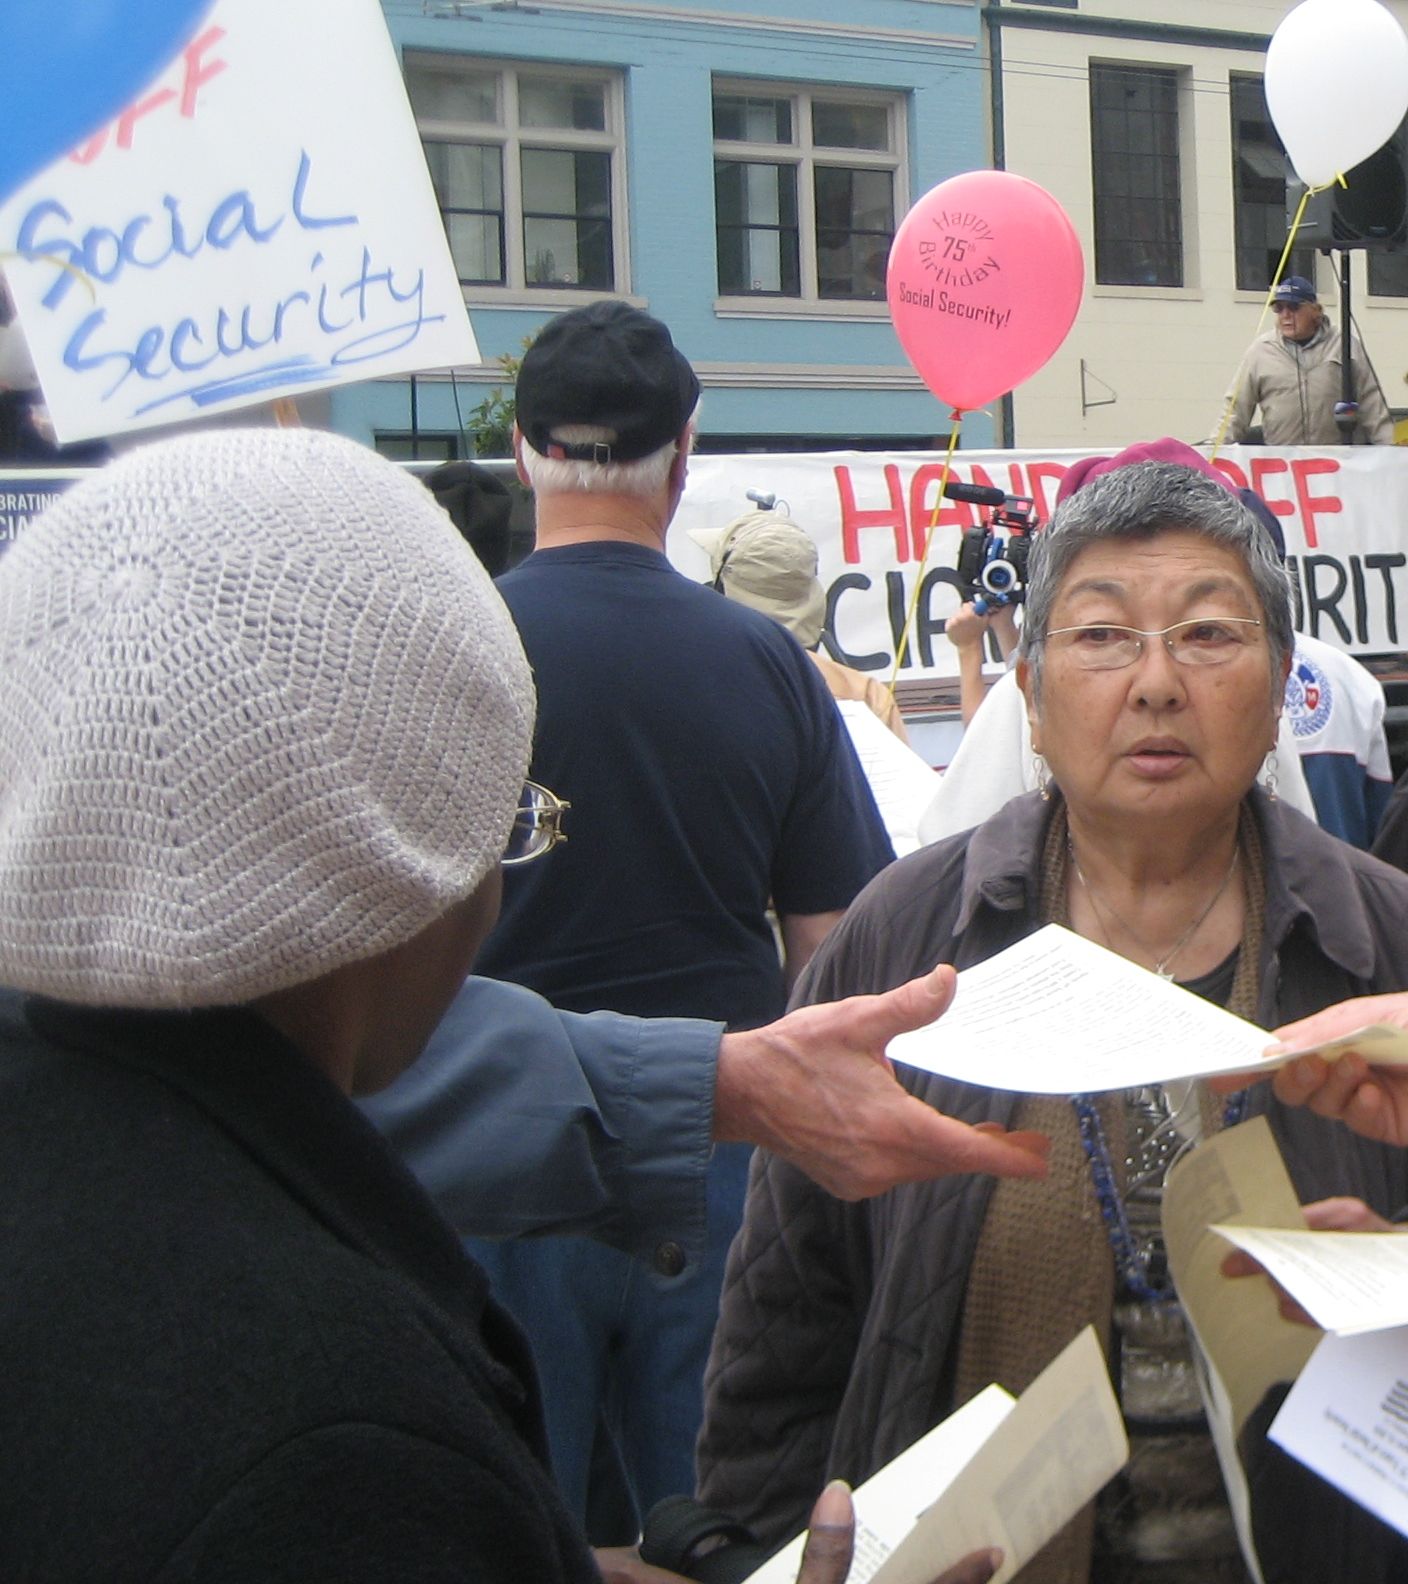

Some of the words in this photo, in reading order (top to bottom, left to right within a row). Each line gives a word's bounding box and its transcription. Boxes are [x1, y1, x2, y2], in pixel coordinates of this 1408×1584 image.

[932, 210, 995, 241] Happy
[918, 240, 1001, 288] Birthday
[63, 243, 446, 401] Security
[899, 281, 935, 309] Social
[938, 290, 1012, 330] Security!
[1212, 457, 1344, 549] FF
